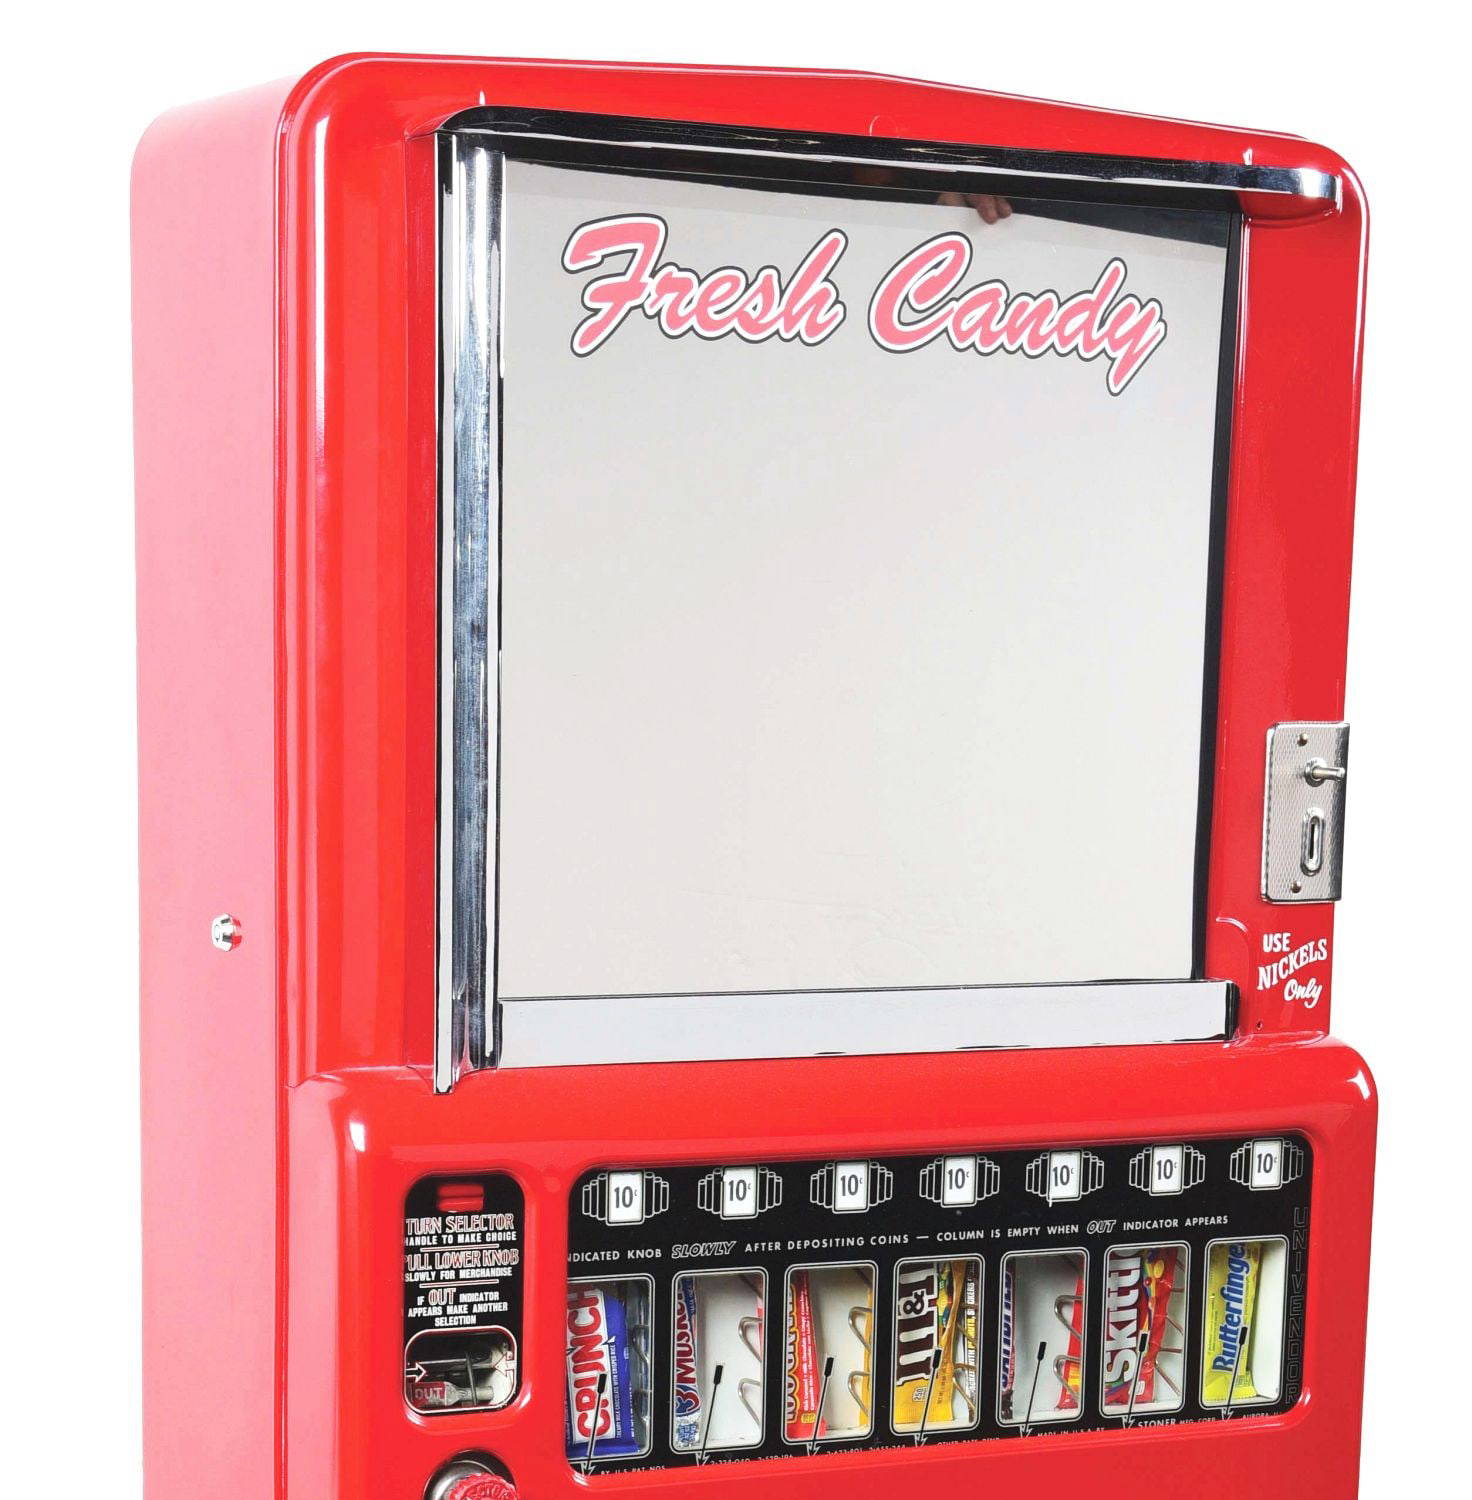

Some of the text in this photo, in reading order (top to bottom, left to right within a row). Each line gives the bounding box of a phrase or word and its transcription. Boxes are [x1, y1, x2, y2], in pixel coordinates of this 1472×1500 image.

[562, 213, 1167, 397] Fresh Candy
[1262, 932, 1292, 953] USE
[1256, 938, 1328, 991] NICKELS
[1283, 977, 1324, 1009] Only
[405, 1213, 514, 1235] TURN SELECTOR
[442, 1234, 454, 1244] TO
[457, 1233, 482, 1243] MAKE
[486, 1231, 517, 1242] CHOICE
[567, 1215, 1229, 1262] NDICATED KNOB SLOWLY AFTER DEPOSITING COINS COLUMN IS EMPTY WHEN OUT INDICATOR APPEARS
[435, 1250, 481, 1270] LOWER
[482, 1248, 520, 1267] KNOB
[405, 1267, 513, 1282] SLOWLY FOR MERCHANDISE
[417, 1287, 500, 1306] IF OUT INDICATOR
[408, 1302, 508, 1317] APPEARS MAKE ANOTHER
[434, 1315, 477, 1327] SELECTION
